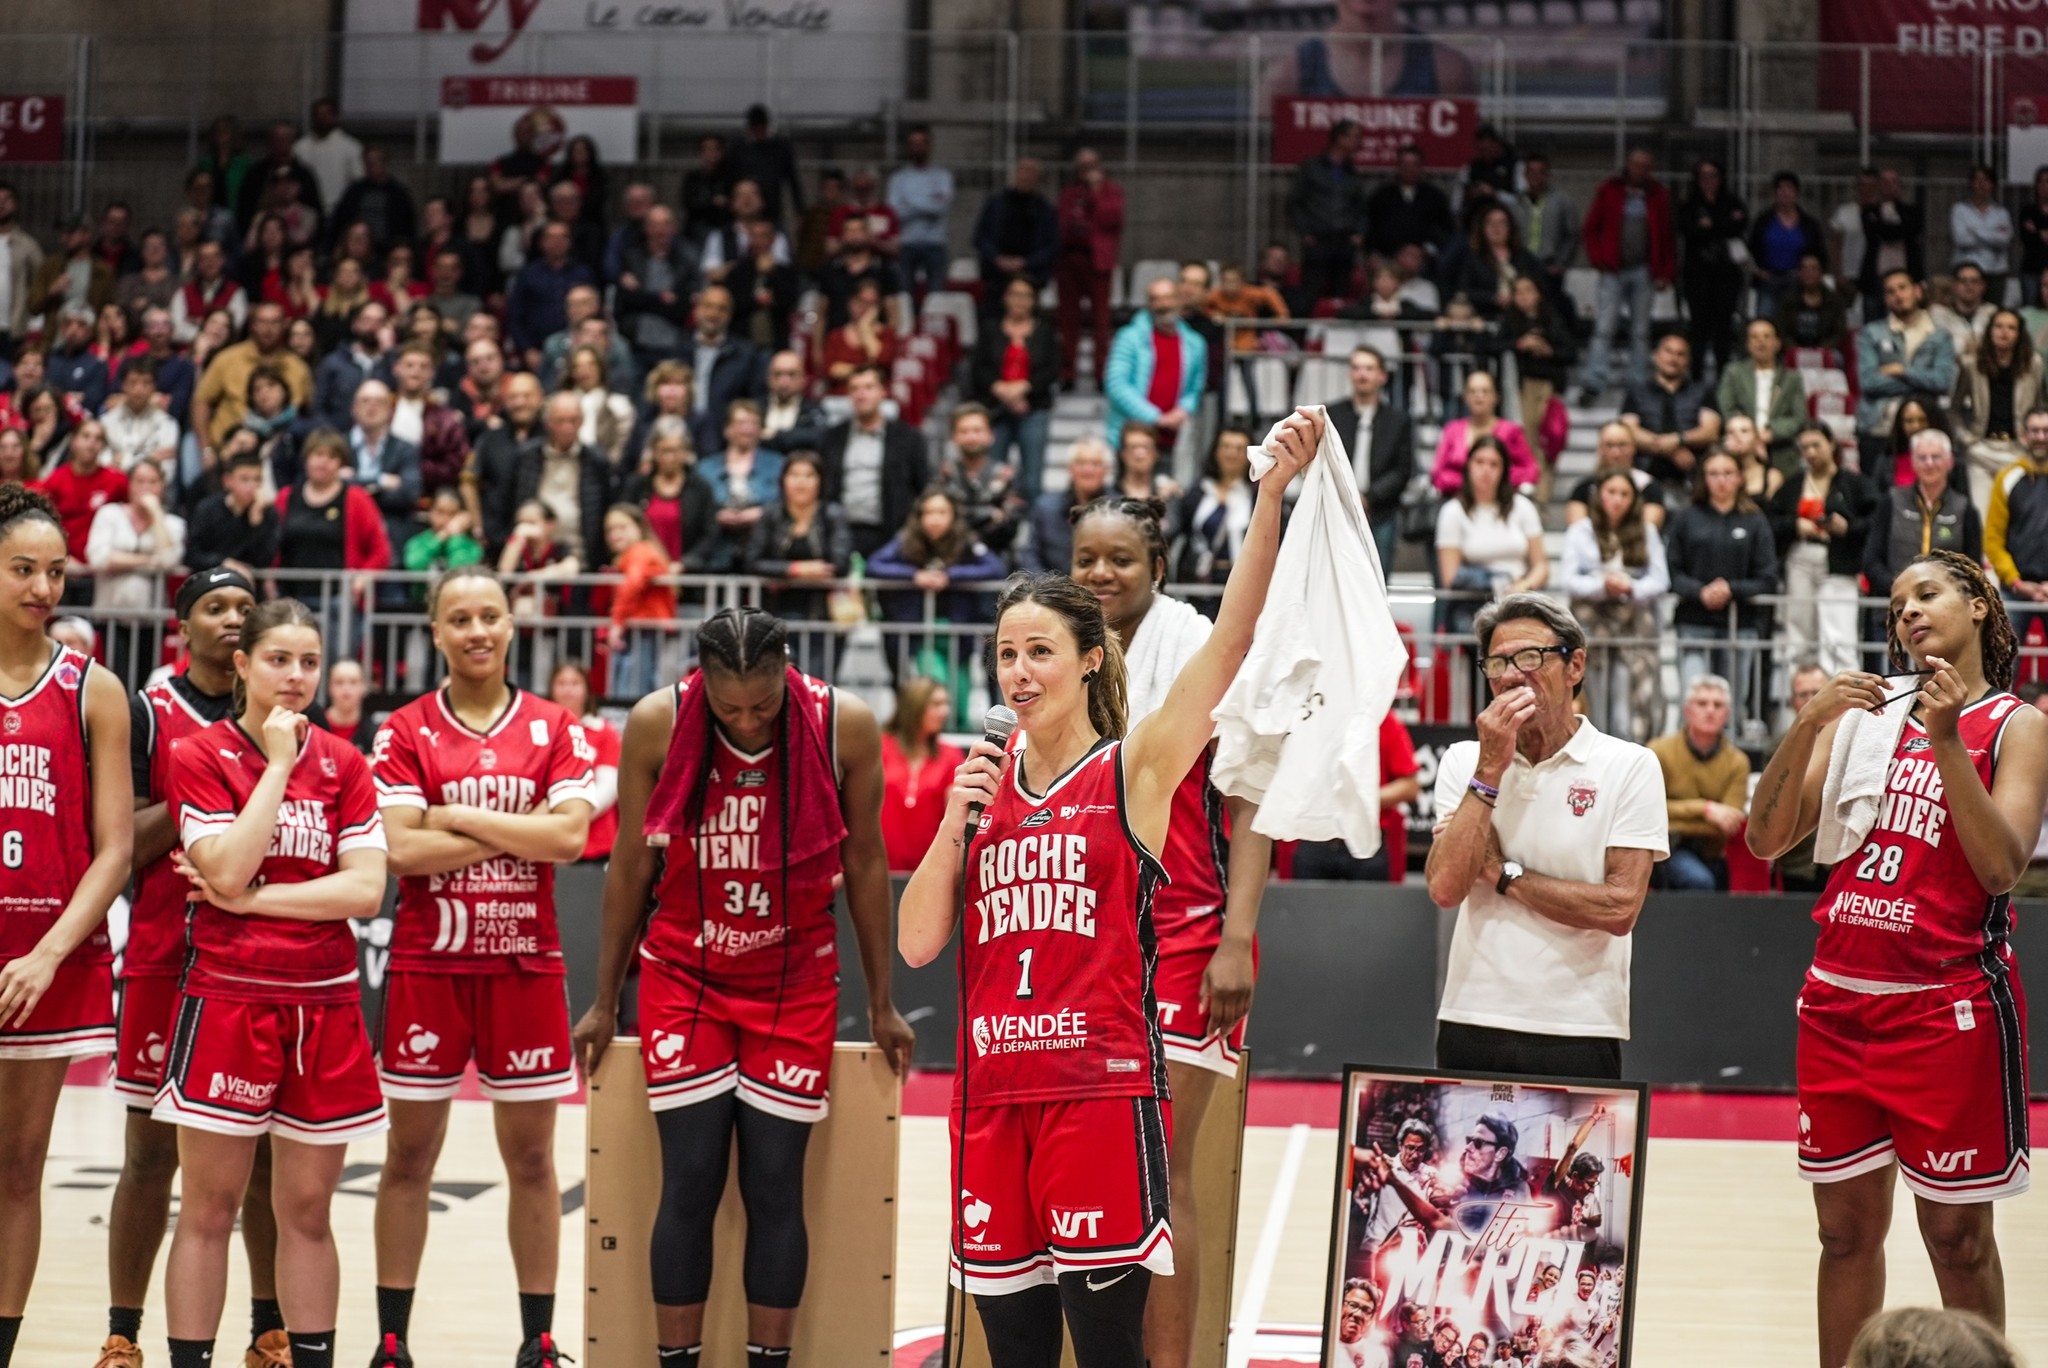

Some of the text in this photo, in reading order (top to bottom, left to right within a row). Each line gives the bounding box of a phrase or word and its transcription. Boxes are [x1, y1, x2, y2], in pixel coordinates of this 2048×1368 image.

[1896, 13, 2048, 57] FIÈRE D
[489, 79, 590, 99] TRIBUNE
[21, 97, 46, 132] C
[1292, 100, 1459, 137] TRIBUNE C
[3, 829, 24, 870] 6
[265, 825, 332, 867] ENDEE
[978, 833, 1088, 894] ROCHE
[1855, 841, 1904, 886] 28
[475, 899, 537, 919] RÉGION
[723, 880, 771, 918] 34
[1842, 891, 1917, 925] VENDÉE
[474, 919, 519, 936] PAYS
[1838, 913, 1913, 935] LE DÉPARTEMENT
[489, 936, 538, 954] LOIRE
[1015, 947, 1035, 1000] 1
[991, 1007, 1088, 1041] VENDÉE
[990, 1037, 1088, 1055] LE DÉPARTEMENT
[957, 1242, 1001, 1252] ARPENTIER
[1378, 1226, 1587, 1332] MERCI
